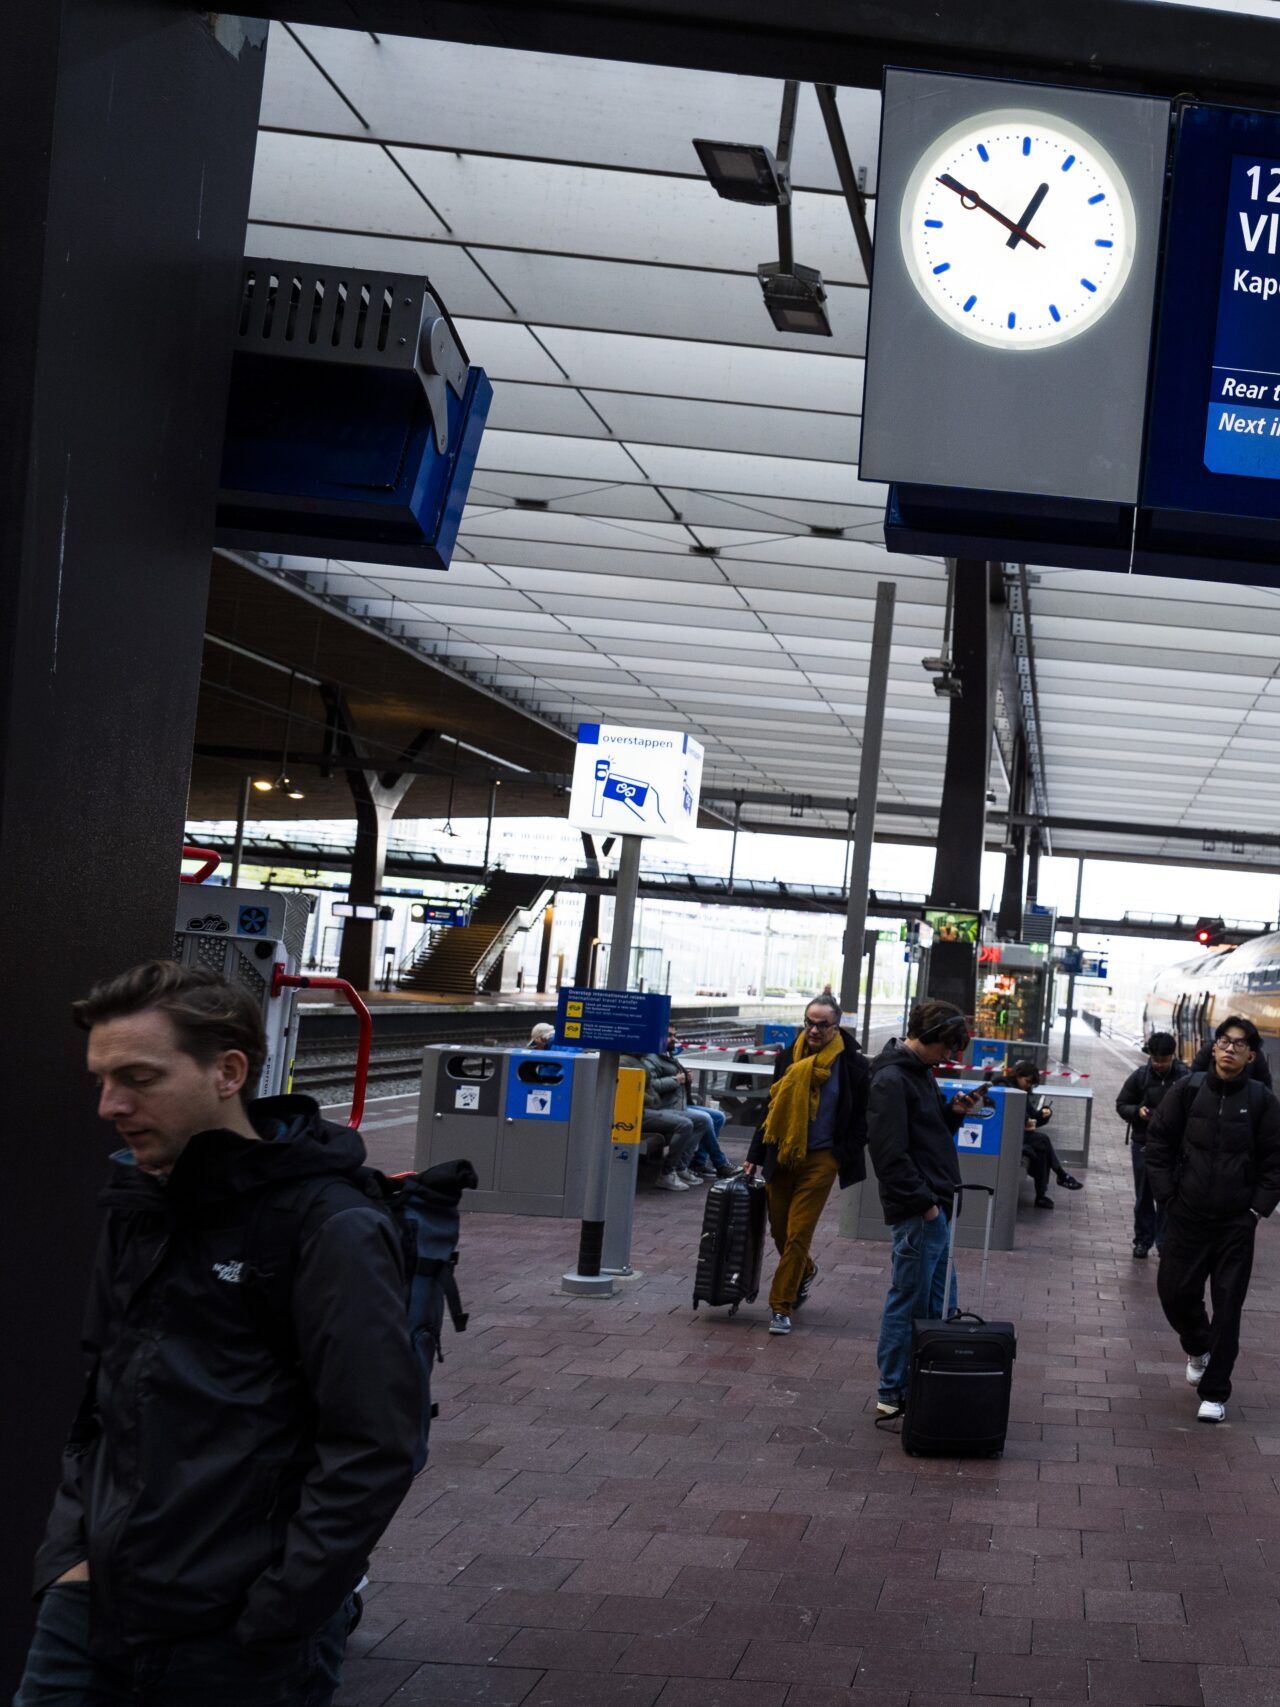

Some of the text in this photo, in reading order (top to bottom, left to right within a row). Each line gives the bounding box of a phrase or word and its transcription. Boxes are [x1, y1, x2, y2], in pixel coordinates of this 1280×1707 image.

[1221, 377, 1268, 399] Rear
[1218, 412, 1267, 435] Next
[602, 735, 673, 749] overstappen
